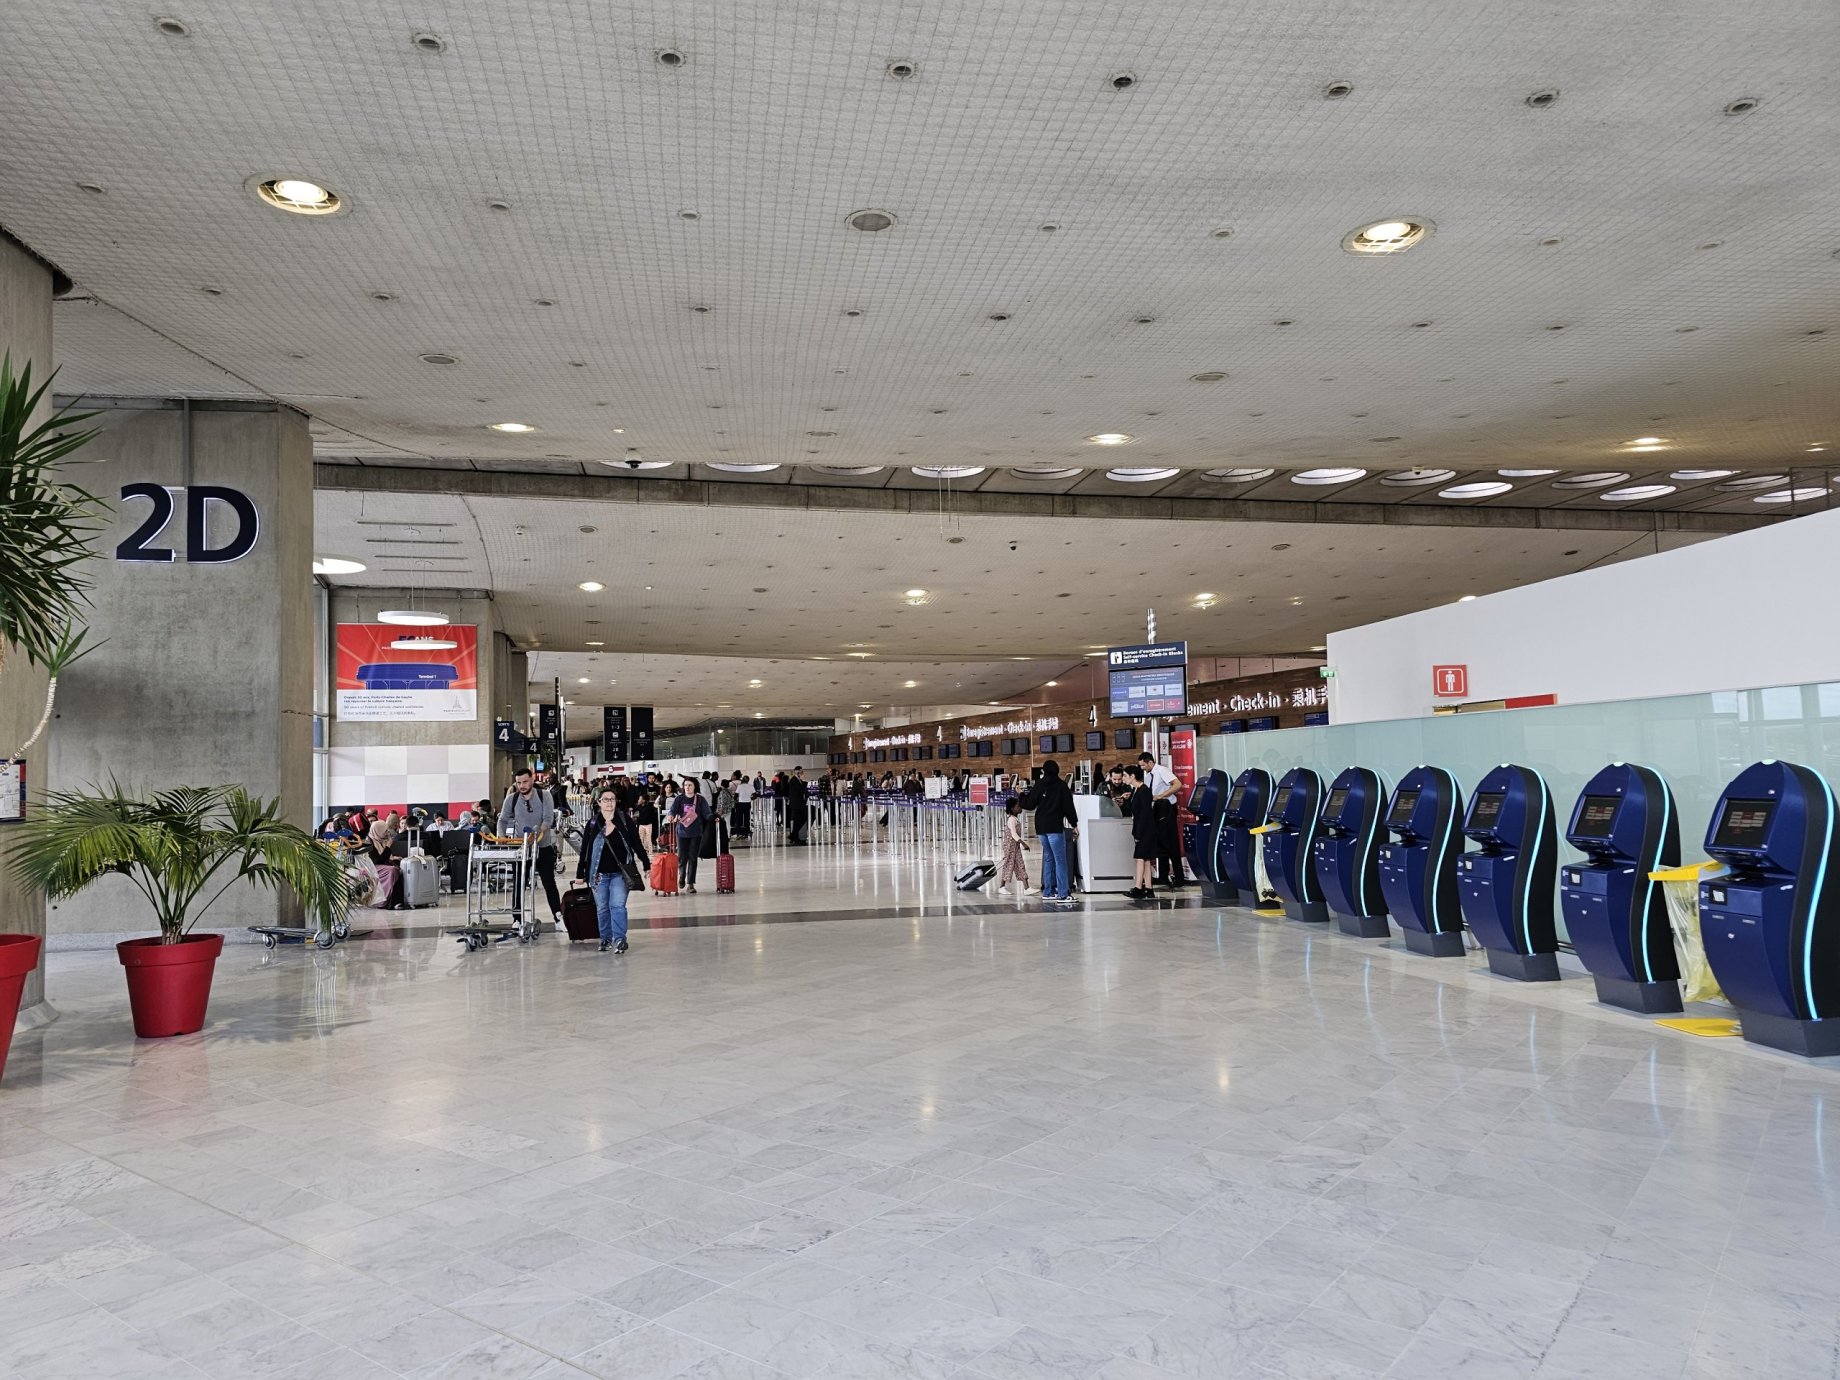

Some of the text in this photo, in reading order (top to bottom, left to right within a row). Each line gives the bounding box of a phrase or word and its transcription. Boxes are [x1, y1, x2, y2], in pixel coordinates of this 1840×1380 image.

[116, 482, 260, 564] 2D
[1230, 691, 1281, 712] Check-in
[1291, 685, 1328, 707] 乘机手
[1088, 704, 1098, 728] 4
[498, 728, 510, 742] 4
[936, 725, 943, 742] 4
[530, 742, 538, 753] 4
